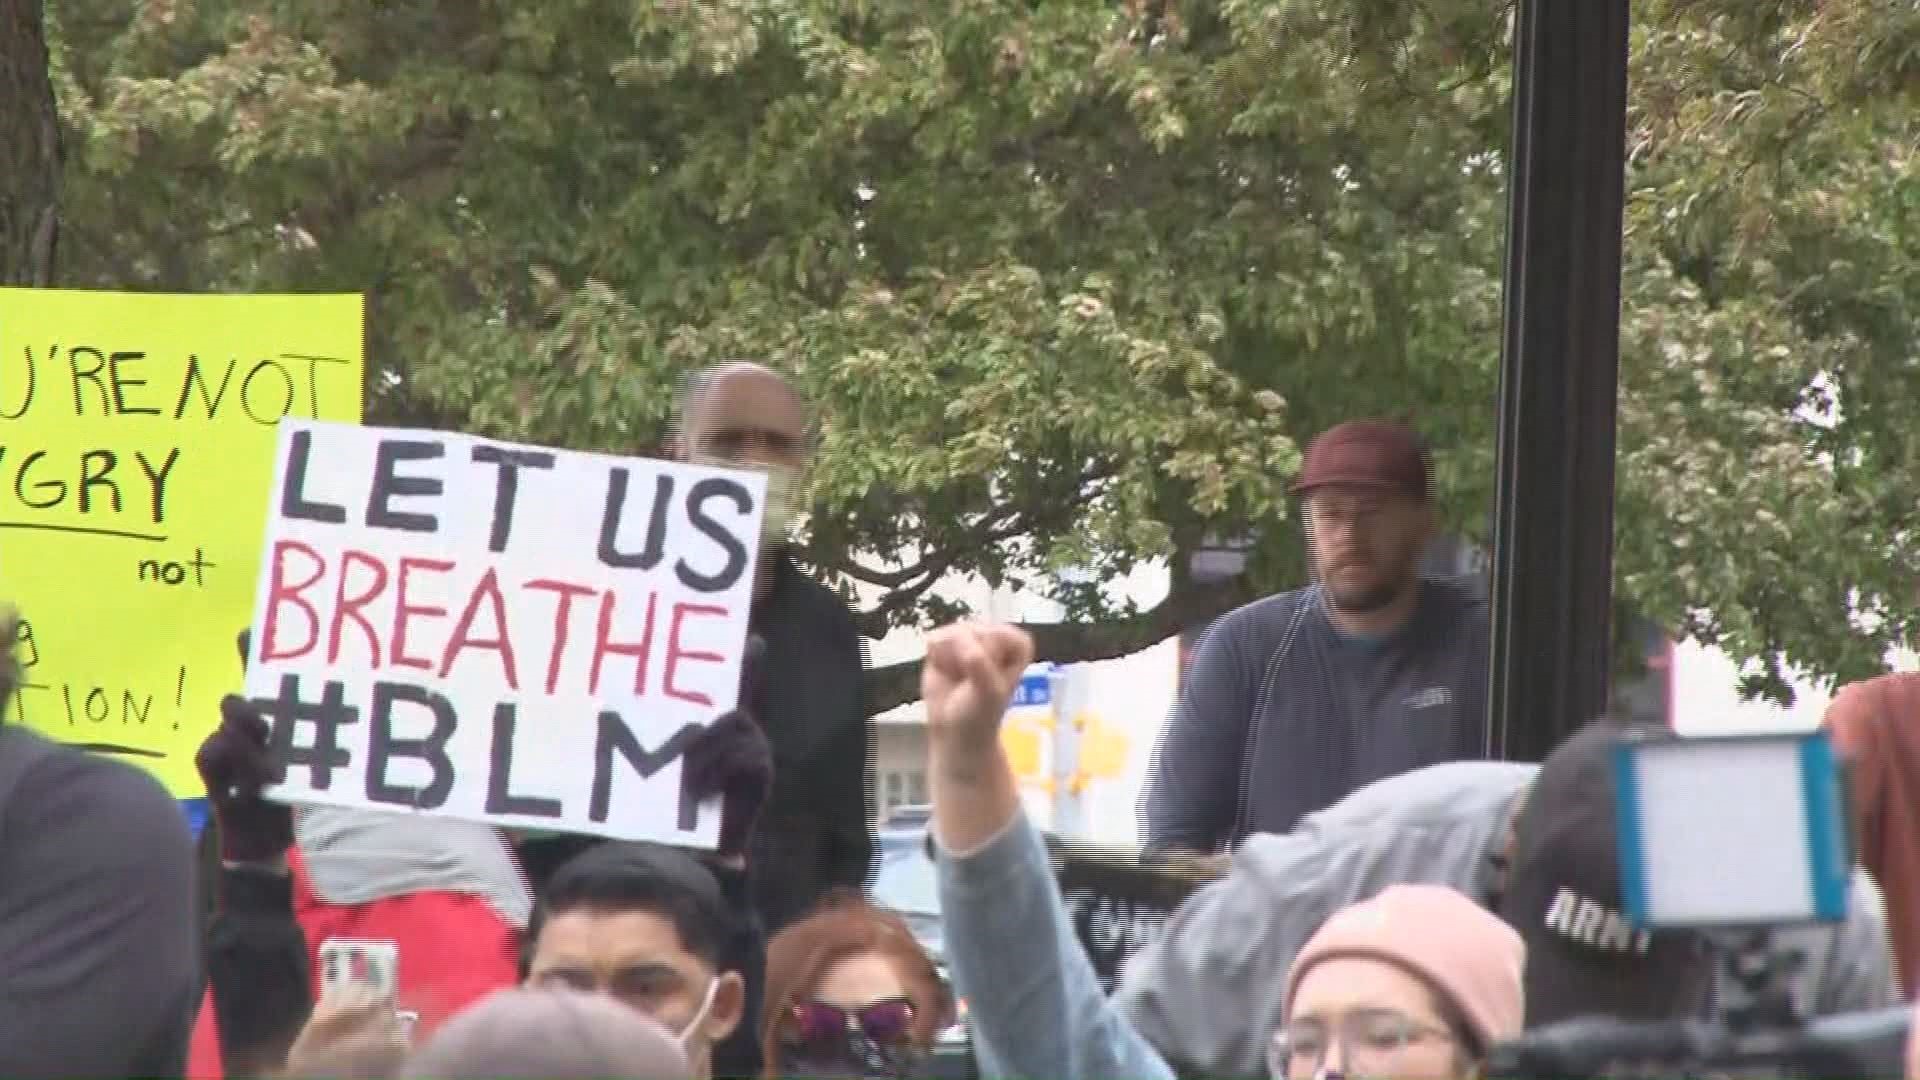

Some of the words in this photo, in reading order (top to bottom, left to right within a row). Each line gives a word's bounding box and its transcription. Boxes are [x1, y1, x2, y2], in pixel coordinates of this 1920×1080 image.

[174, 353, 351, 426] NOT
[0, 446, 180, 524] GRY
[281, 430, 555, 552] LET
[597, 467, 753, 593] US
[139, 547, 216, 587] not
[260, 540, 730, 706] BREATHE
[250, 673, 710, 831] #BLM
